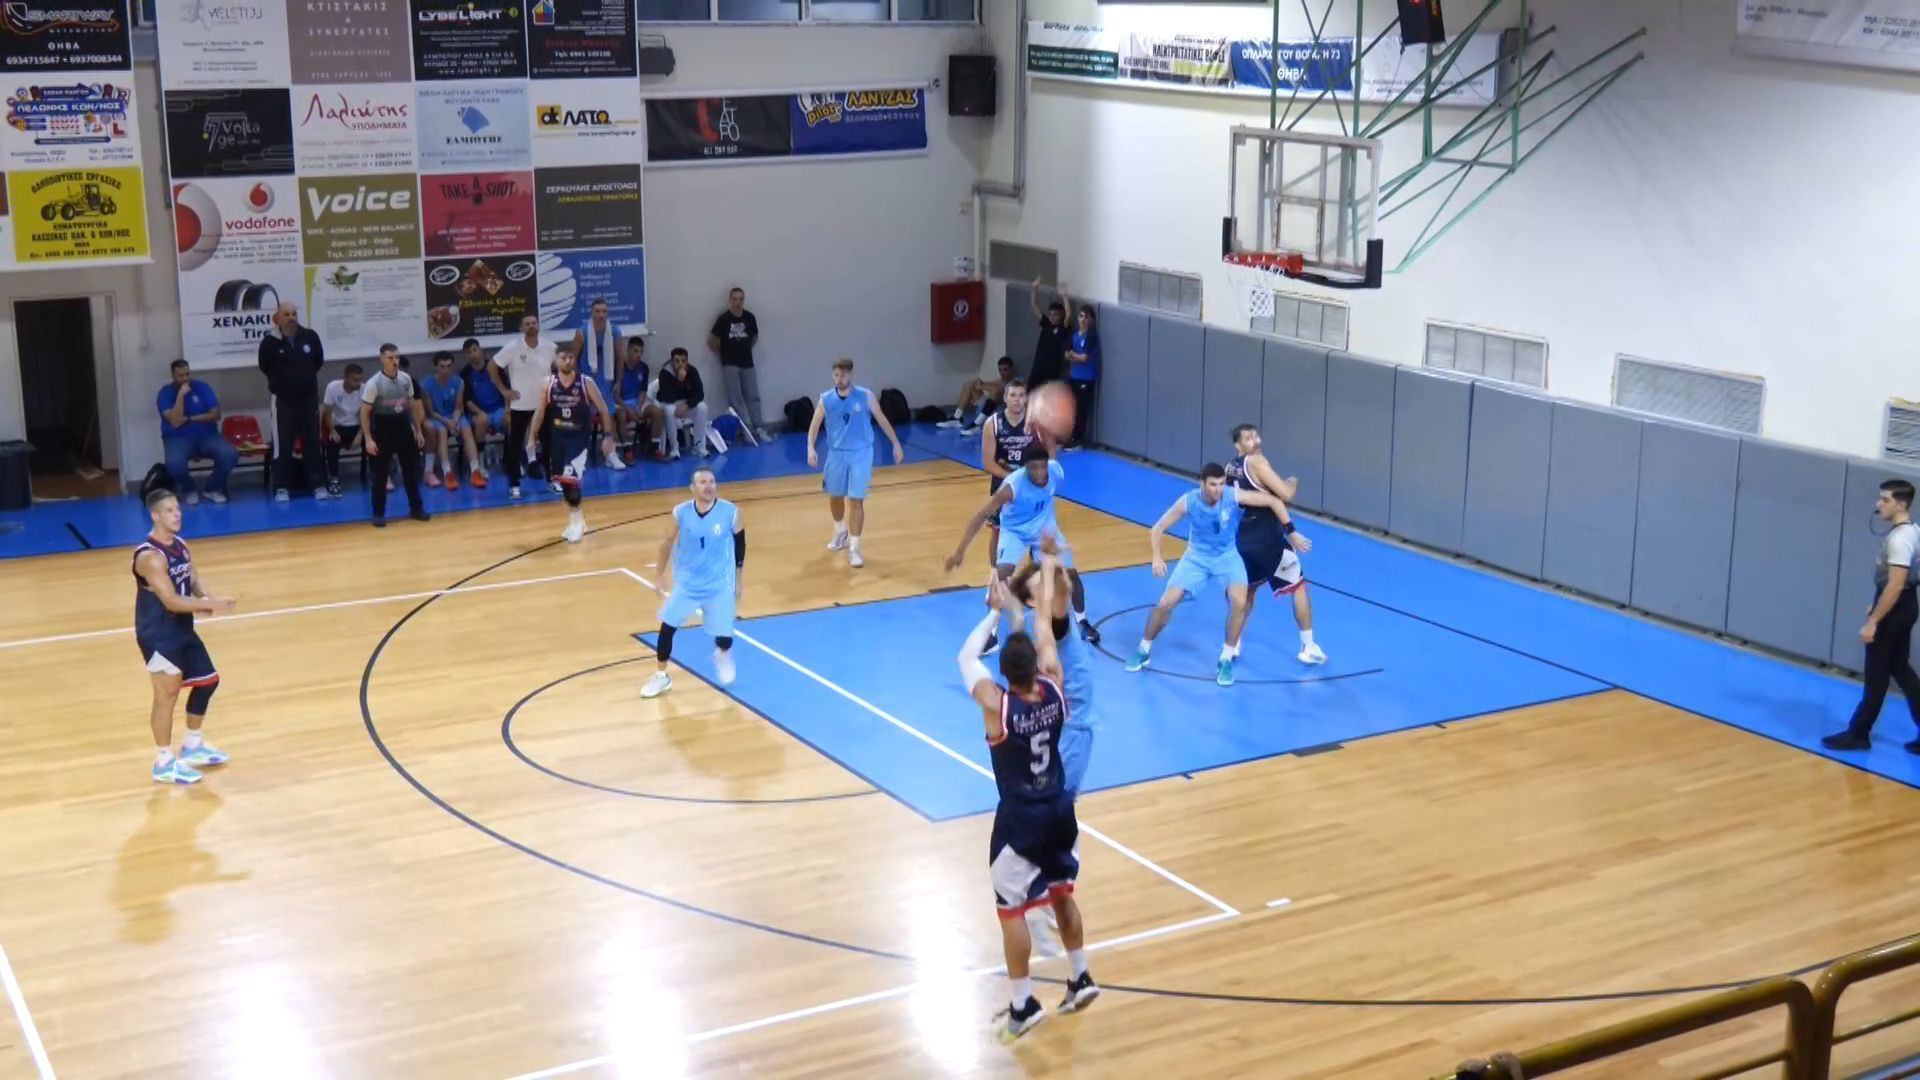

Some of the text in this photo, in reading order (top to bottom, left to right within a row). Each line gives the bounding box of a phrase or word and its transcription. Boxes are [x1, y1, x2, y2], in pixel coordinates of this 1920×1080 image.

[440, 183, 469, 199] TAKE
[485, 181, 516, 197] SHOT
[225, 216, 295, 231] vodafone
[1029, 730, 1050, 776] 5
